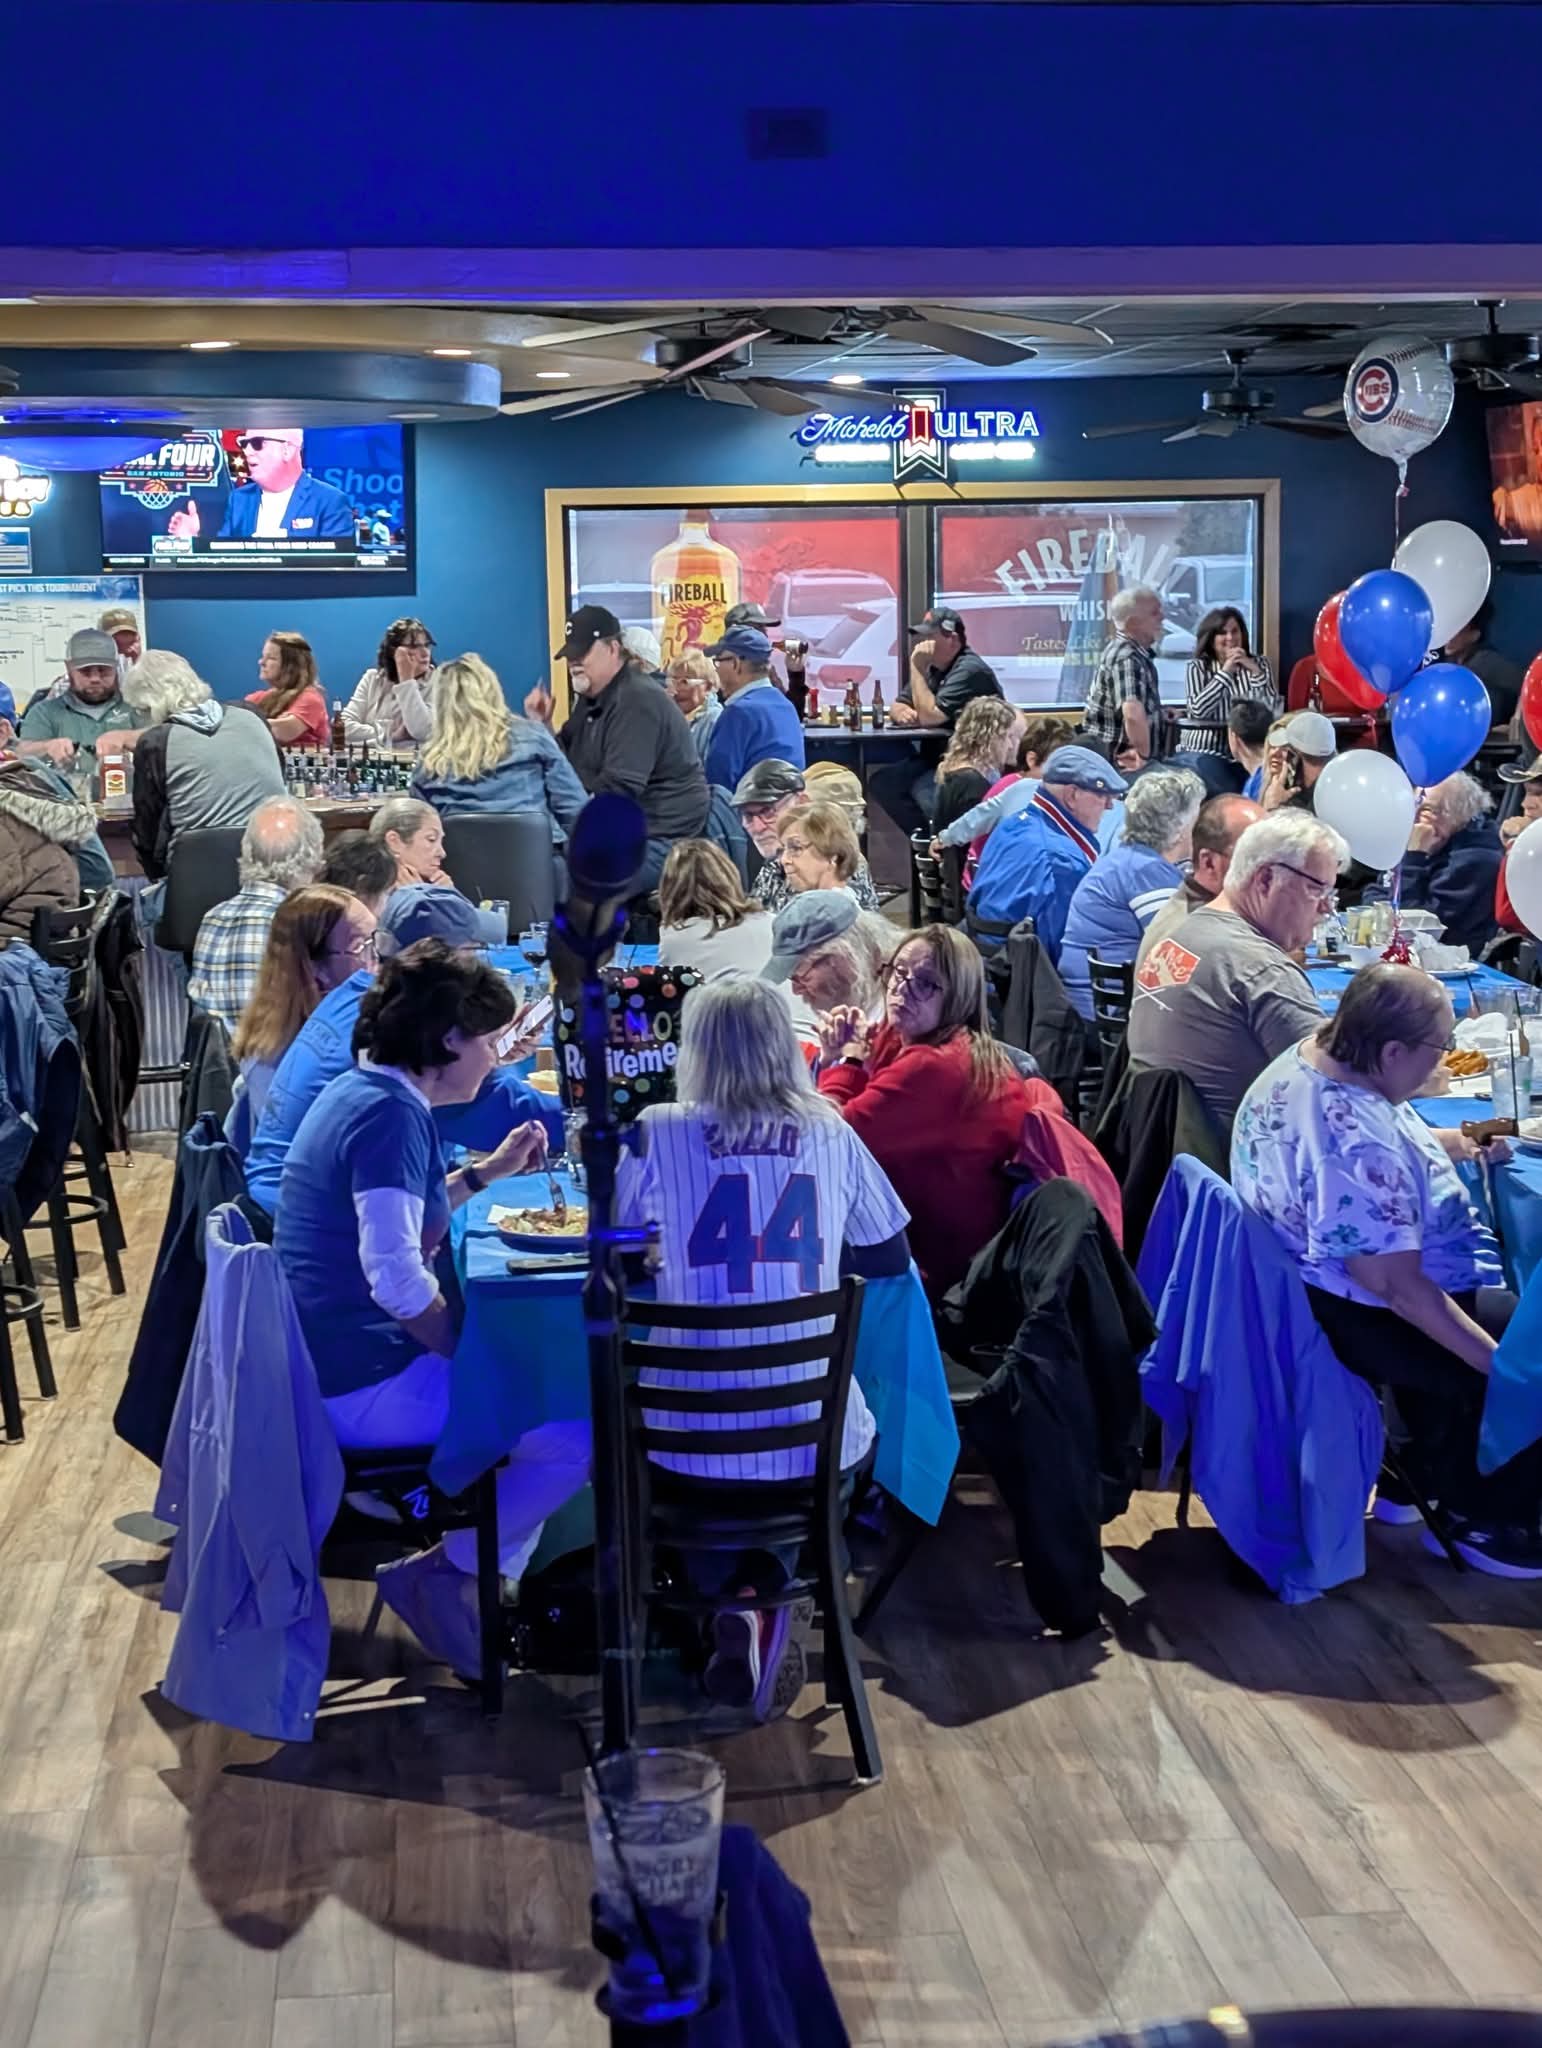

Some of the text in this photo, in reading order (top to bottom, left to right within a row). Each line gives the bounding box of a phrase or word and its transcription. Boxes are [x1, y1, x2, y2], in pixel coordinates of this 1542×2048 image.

[801, 411, 1040, 442] Michelob ULTRA
[159, 443, 215, 466] FOUR
[660, 582, 727, 606] FIREBALL
[1060, 600, 1113, 622] WHIS
[1022, 633, 1065, 651] Tastes
[609, 1008, 672, 1043] ELLO
[564, 1041, 678, 1080] Rireme
[687, 1173, 824, 1295] 44
